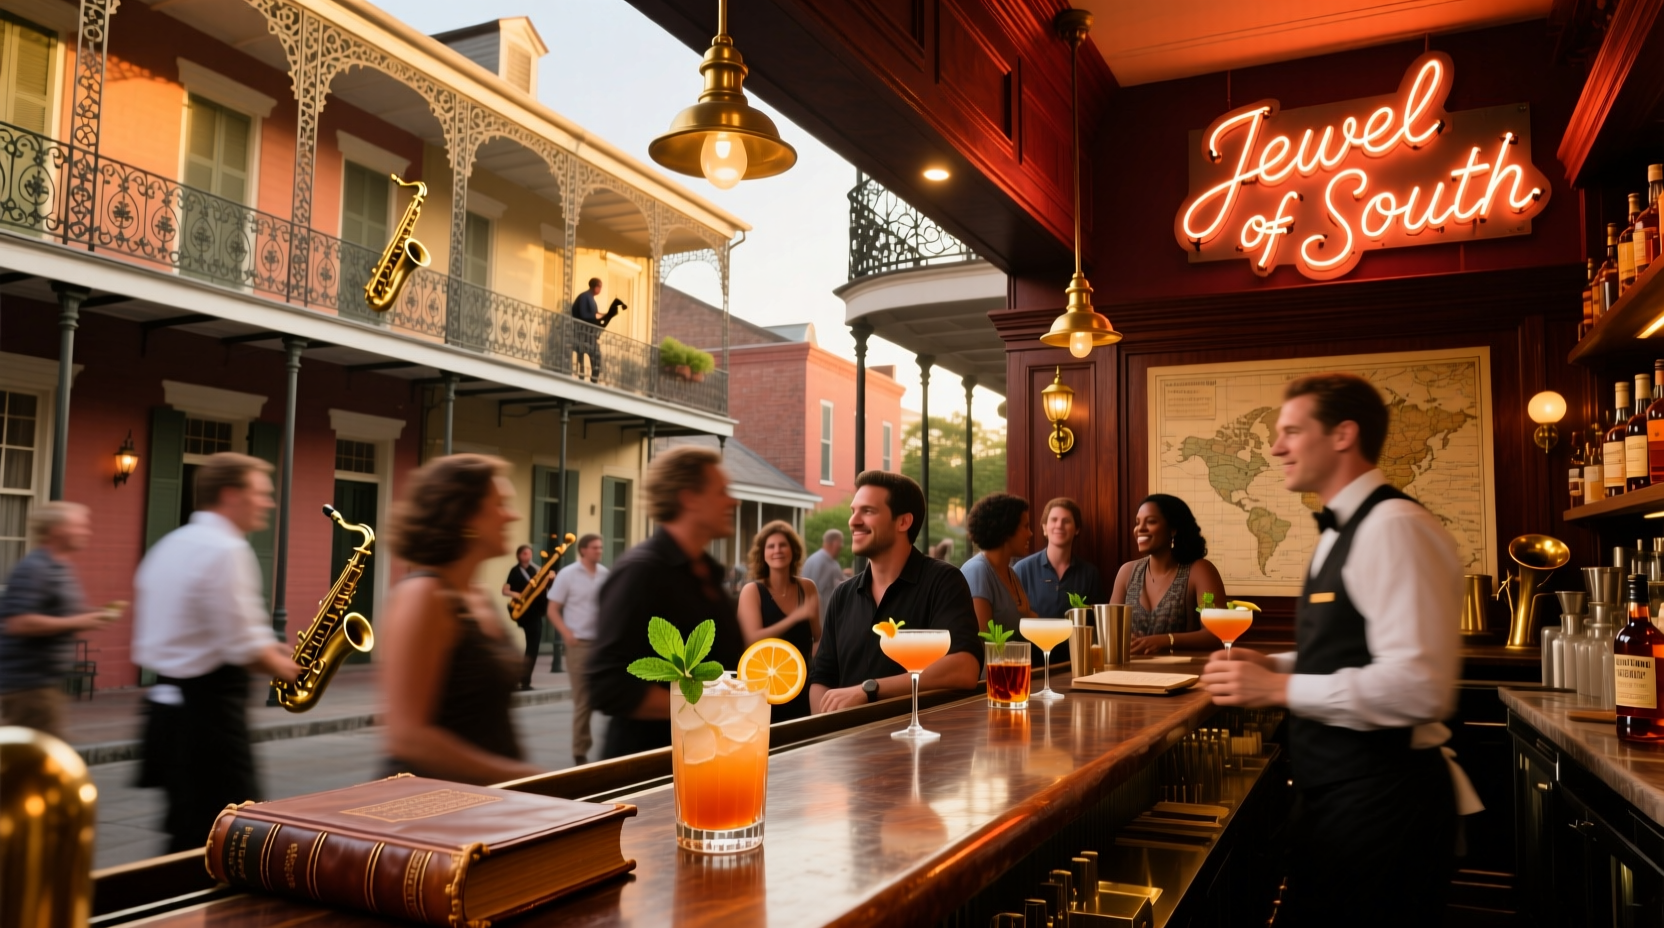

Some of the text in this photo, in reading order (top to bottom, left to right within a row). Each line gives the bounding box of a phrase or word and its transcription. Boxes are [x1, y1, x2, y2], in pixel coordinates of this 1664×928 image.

[1183, 59, 1444, 239] Jewel
[1239, 132, 1542, 270] of South
